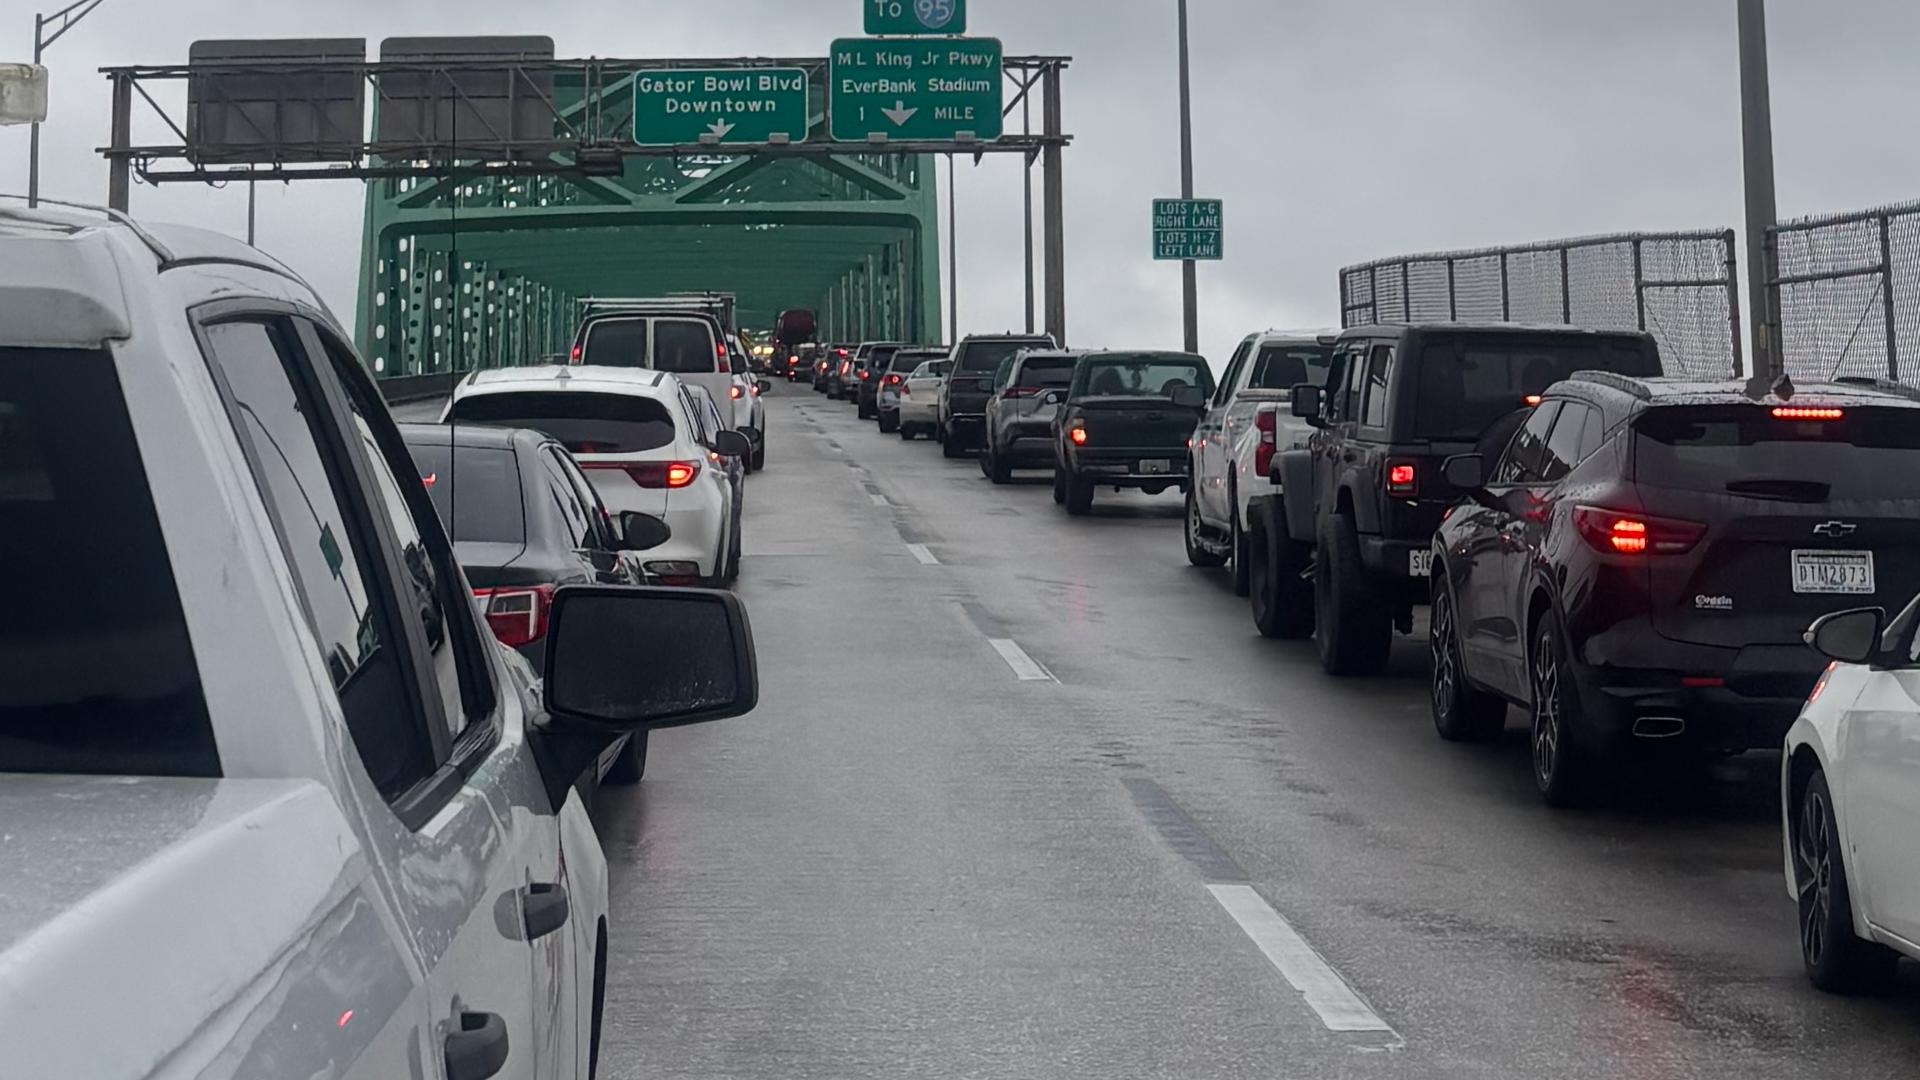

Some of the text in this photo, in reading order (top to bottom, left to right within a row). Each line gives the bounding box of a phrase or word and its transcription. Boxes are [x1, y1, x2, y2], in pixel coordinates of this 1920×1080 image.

[875, 0, 951, 20] To 95
[838, 51, 994, 69] M L King Jr Pkwy
[640, 75, 803, 93] Gator Bowl Blvd
[842, 78, 990, 93] EverBank Stadium
[665, 97, 776, 113] Downtown
[859, 106, 974, 121] 1 MILE
[1160, 203, 1187, 215] LOTS
[1156, 215, 1219, 228] RIGHT LANE
[1160, 231, 1187, 244] LOTS
[1159, 244, 1217, 257] LEFT LANE
